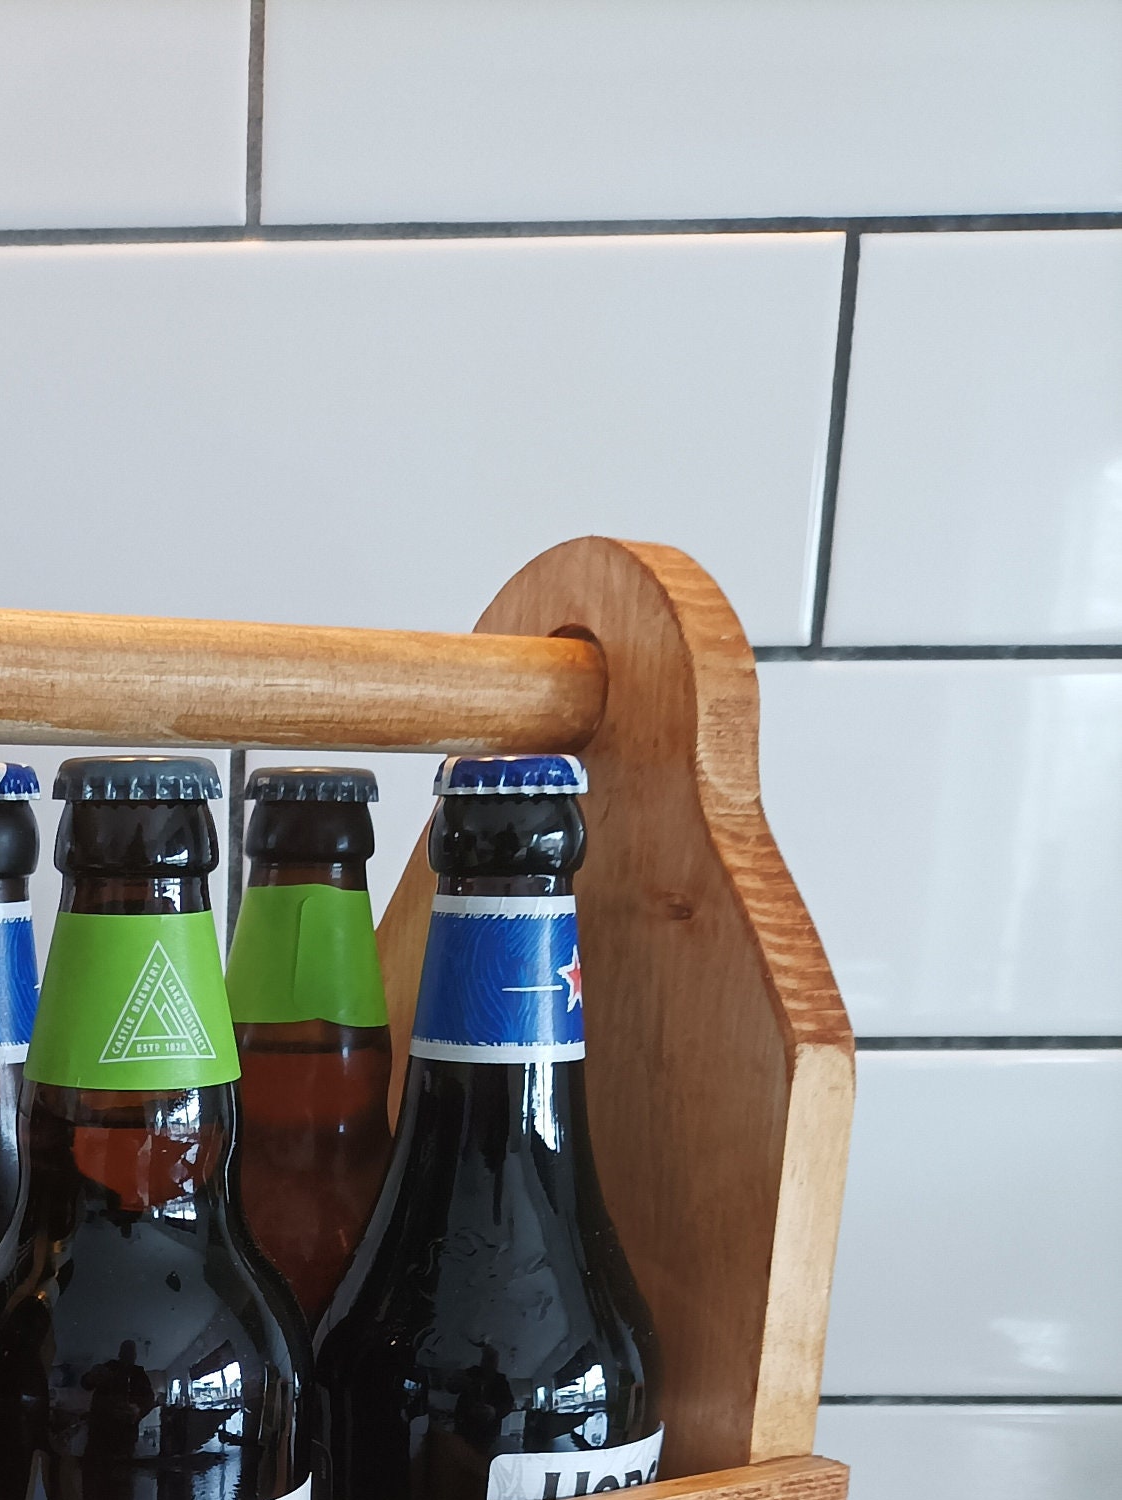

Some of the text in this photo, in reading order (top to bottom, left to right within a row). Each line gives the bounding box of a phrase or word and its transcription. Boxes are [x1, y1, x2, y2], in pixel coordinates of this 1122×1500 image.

[112, 962, 161, 1054] CASTLE BREWERY
[166, 979, 207, 1051] LAKE DISTRICT
